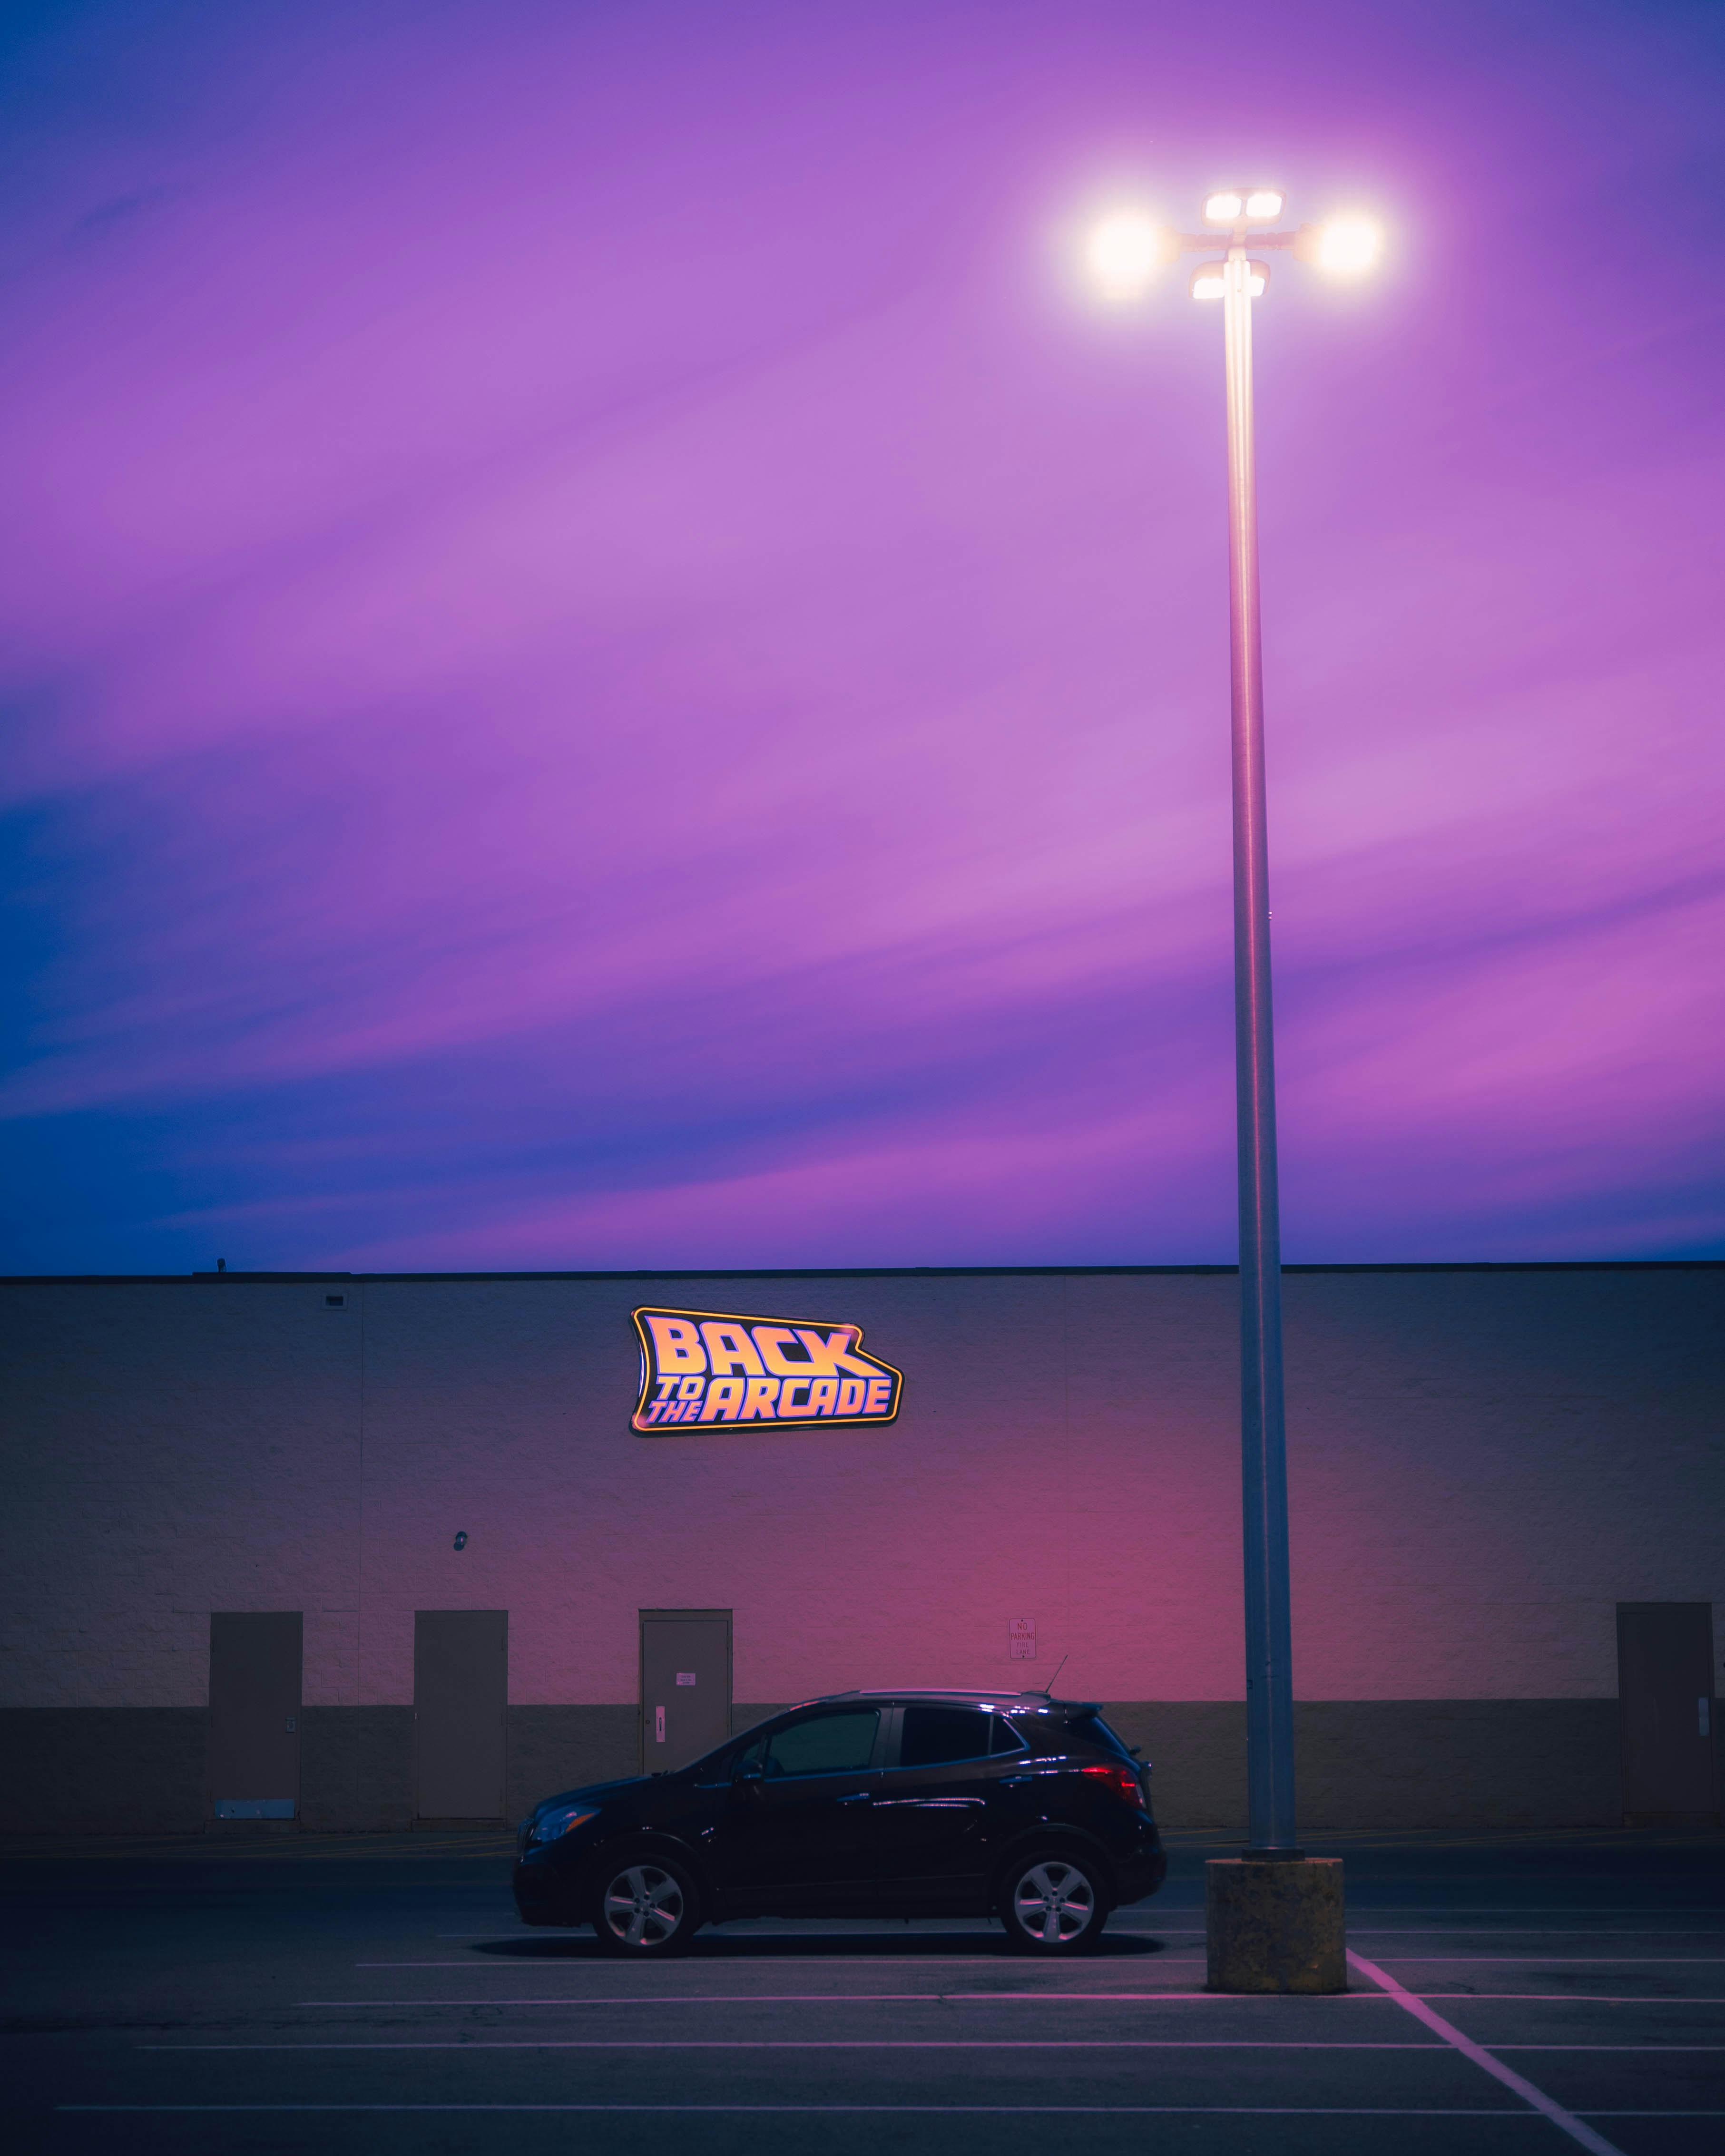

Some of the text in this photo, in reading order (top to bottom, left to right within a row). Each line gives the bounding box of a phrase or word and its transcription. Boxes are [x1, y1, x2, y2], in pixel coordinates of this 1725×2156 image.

[644, 1315, 892, 1378] BACK
[646, 1377, 892, 1424] THE ARCADE
[655, 1375, 706, 1401] TO
[1011, 1632, 1034, 1640] PARKING
[1018, 1622, 1028, 1630] NO
